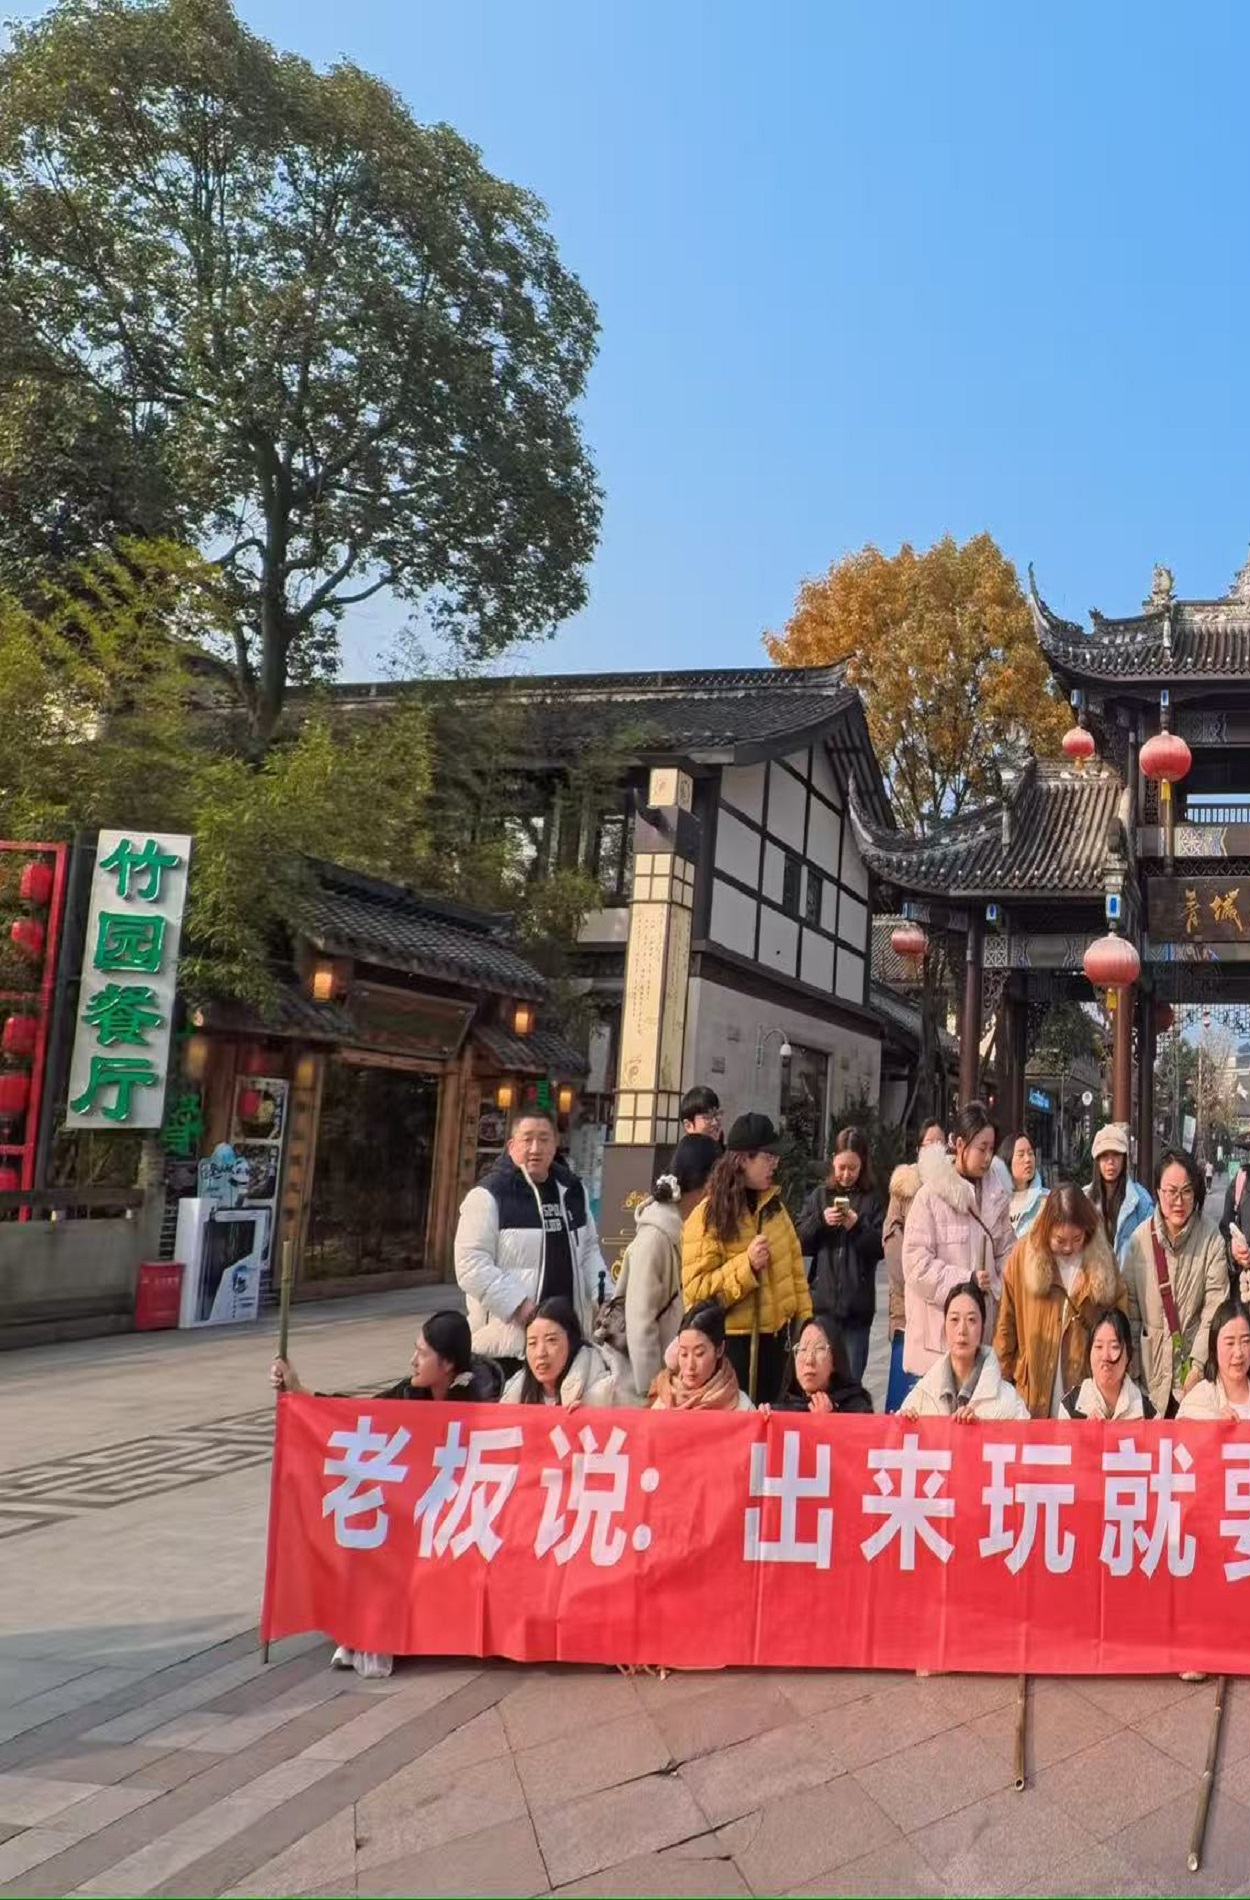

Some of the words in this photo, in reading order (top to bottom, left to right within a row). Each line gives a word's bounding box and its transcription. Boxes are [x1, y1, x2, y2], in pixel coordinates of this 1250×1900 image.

[69, 837, 181, 1121] 竹园餐厅
[322, 1415, 661, 1567] 老板说：
